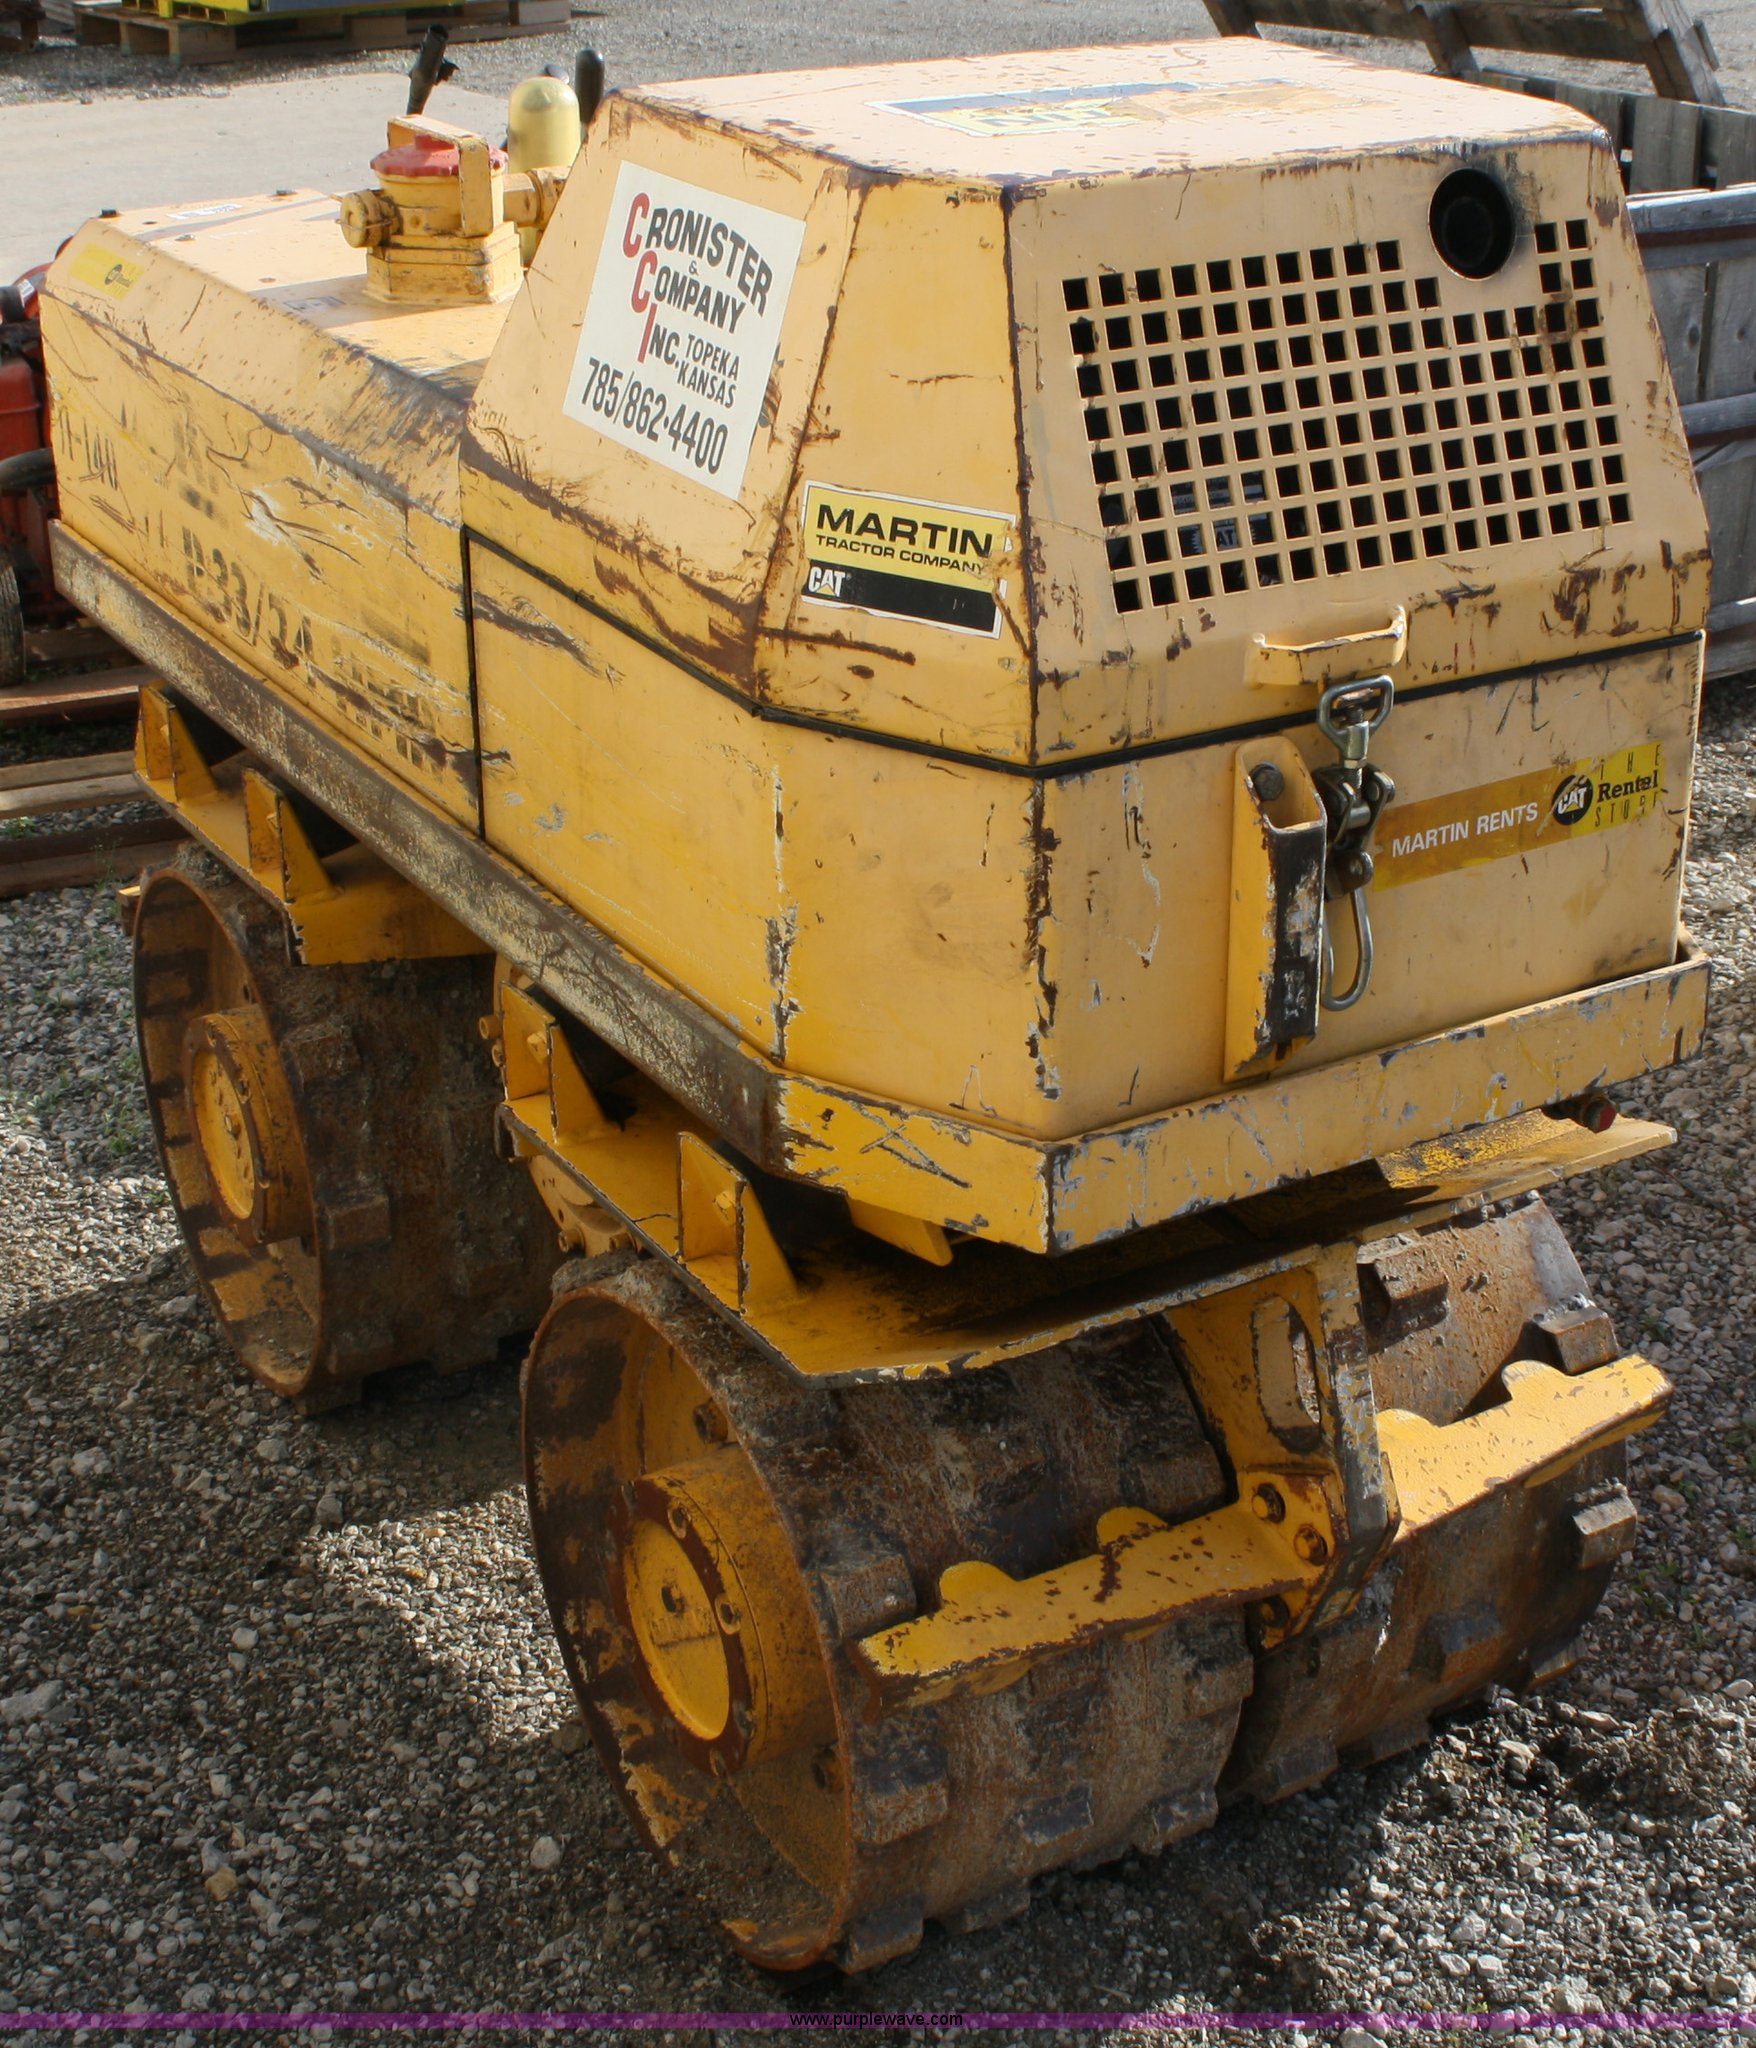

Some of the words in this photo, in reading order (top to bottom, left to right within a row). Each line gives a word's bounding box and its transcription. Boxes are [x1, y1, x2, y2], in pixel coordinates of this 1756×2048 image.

[622, 192, 773, 318] CRONISTER
[688, 259, 699, 275] &
[631, 250, 747, 335] COMPANY
[687, 333, 741, 381] TOPEKA
[676, 362, 738, 410] KANSAS
[815, 534, 895, 559] TRACTOR
[899, 550, 984, 575] COMPANY
[816, 503, 993, 559] MARTIN
[808, 566, 847, 598] CAT
[1557, 787, 1588, 815] CAT
[1597, 769, 1660, 803] Rental
[1392, 819, 1469, 857] MARTIN
[1476, 802, 1539, 836] RENTS
